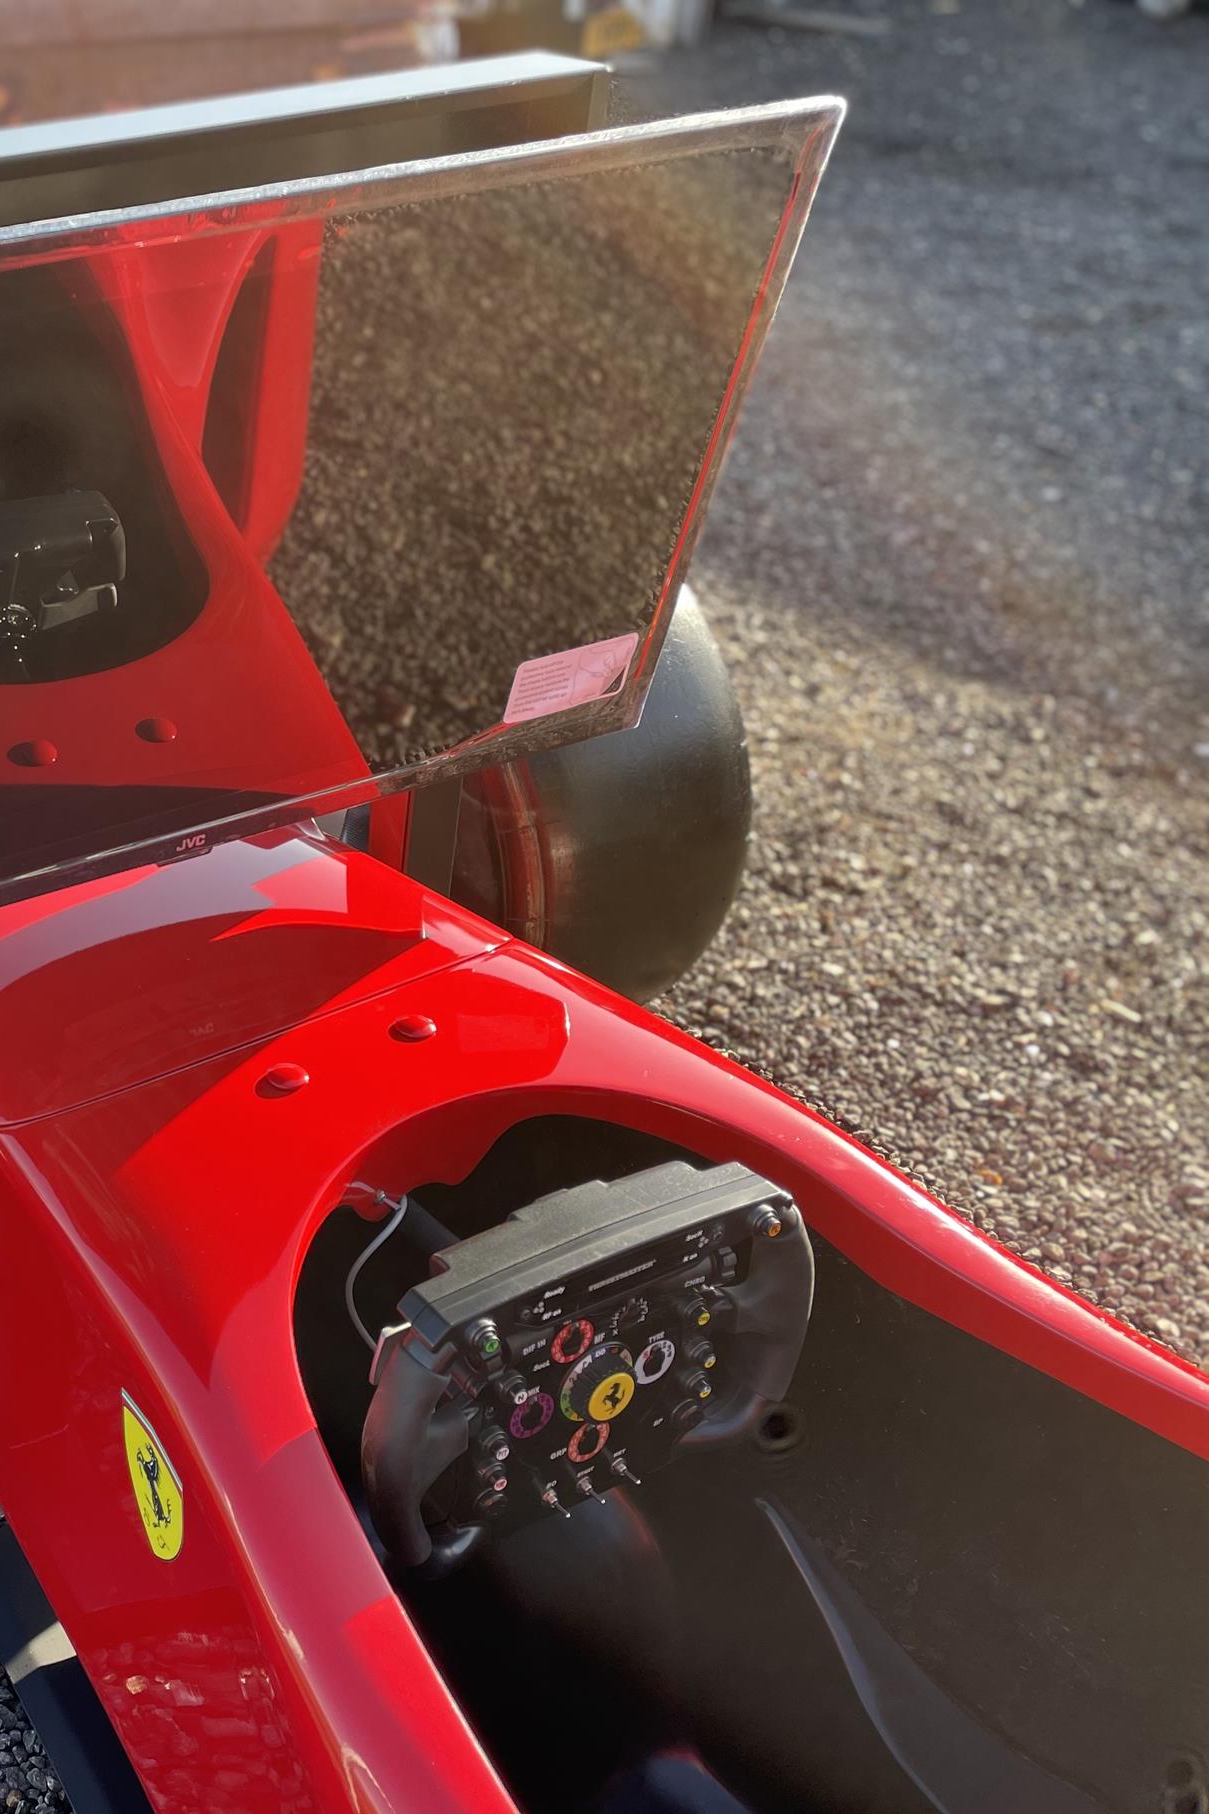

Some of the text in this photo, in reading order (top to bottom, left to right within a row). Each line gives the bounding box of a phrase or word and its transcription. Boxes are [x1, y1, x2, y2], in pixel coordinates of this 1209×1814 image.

[176, 834, 206, 851] JVC
[649, 1331, 666, 1344] TYRE
[523, 1343, 536, 1356] DIF
